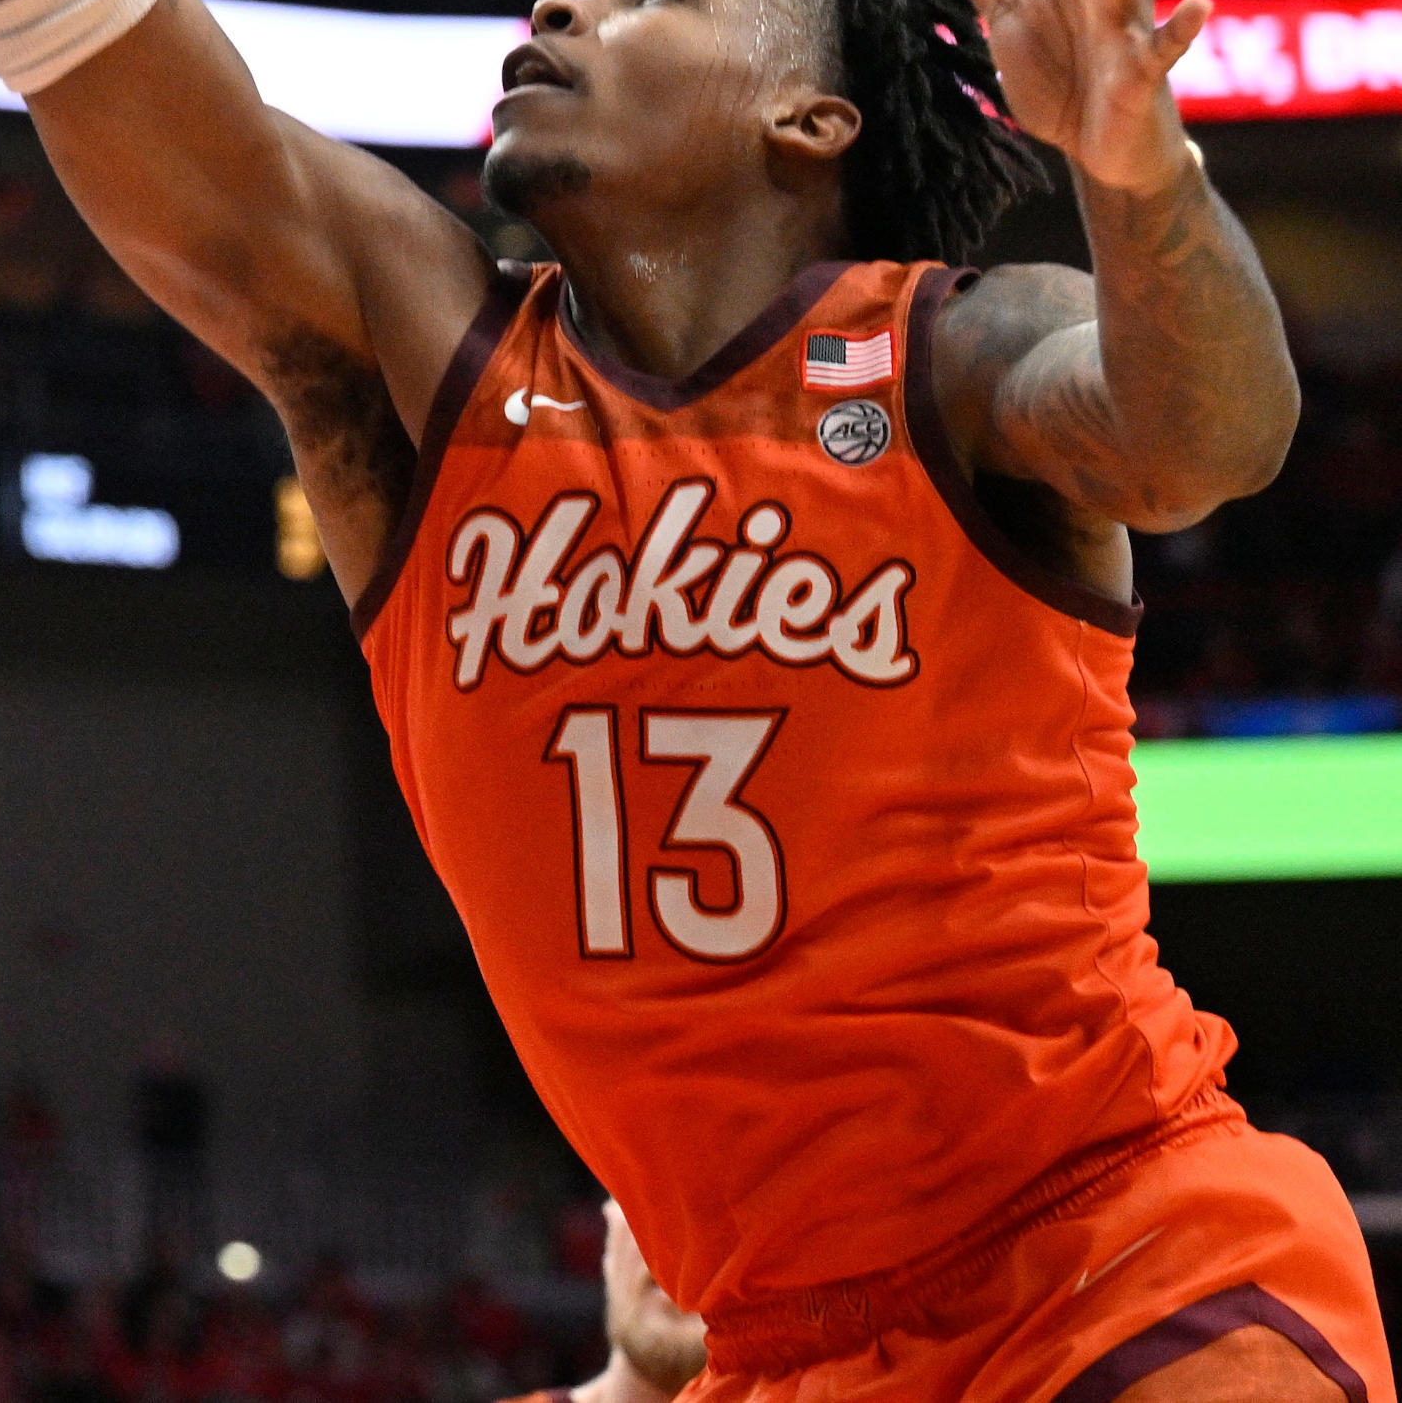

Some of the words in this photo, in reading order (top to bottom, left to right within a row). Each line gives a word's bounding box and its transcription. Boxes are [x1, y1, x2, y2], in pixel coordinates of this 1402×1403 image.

[827, 421, 883, 441] ACC
[447, 477, 920, 692] Hokies
[542, 703, 789, 965] 13
